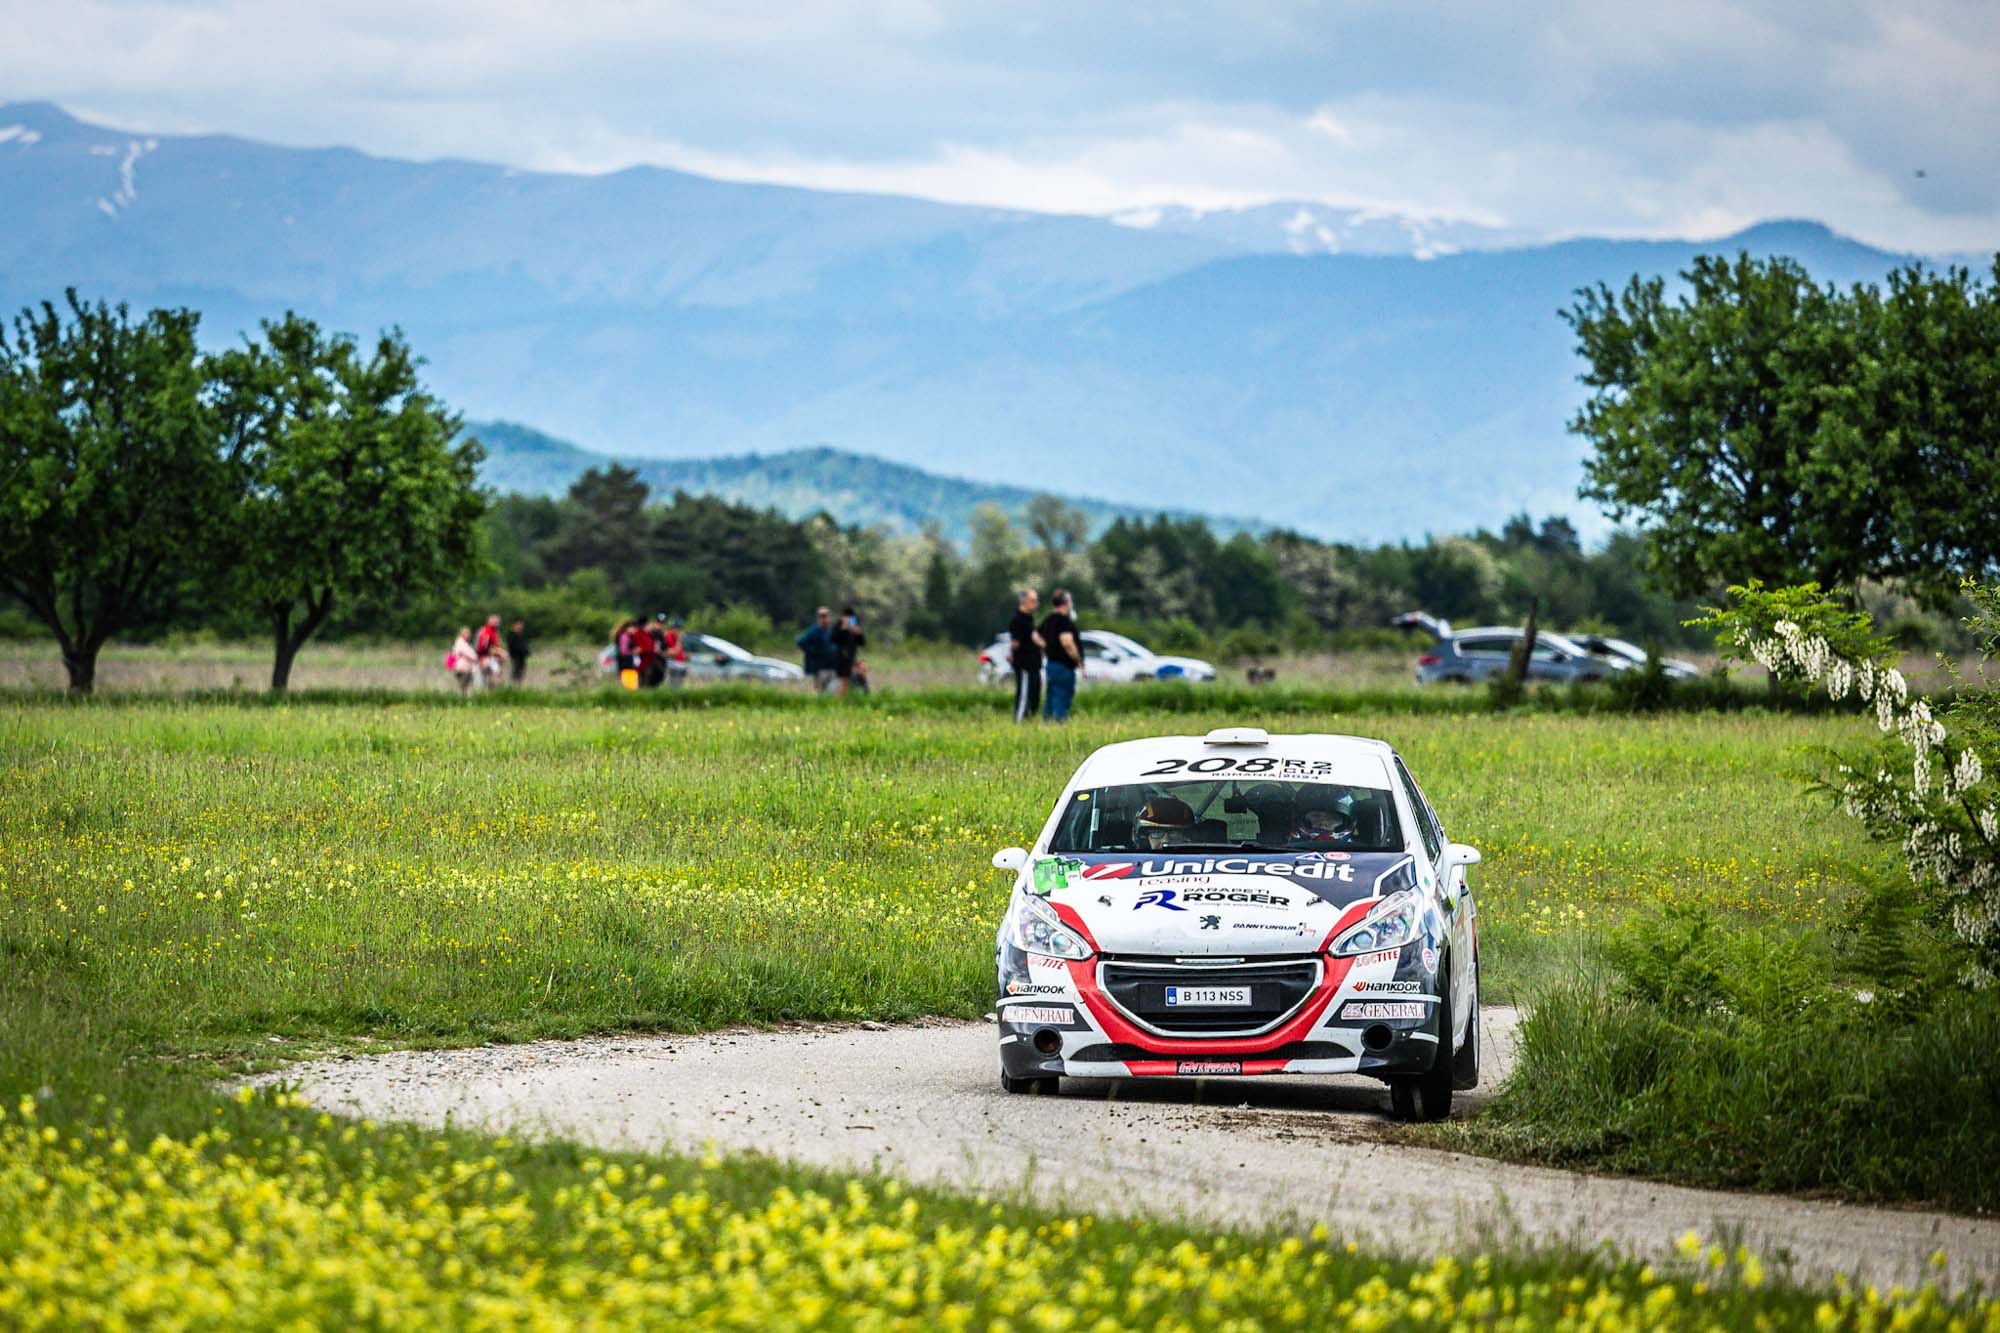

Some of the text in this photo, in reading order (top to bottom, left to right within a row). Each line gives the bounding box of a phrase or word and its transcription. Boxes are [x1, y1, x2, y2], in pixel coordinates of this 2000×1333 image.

[1140, 757, 1333, 776] 208 R2
[1283, 767, 1332, 776] CUP
[1140, 858, 1355, 883] UniCredit
[1138, 876, 1211, 887] Leasing
[1182, 892, 1291, 907] ROGER
[1183, 991, 1244, 1001] B 113 NSS
[1014, 1006, 1073, 1023] GENERALI
[1363, 1003, 1424, 1018] GENERALI
